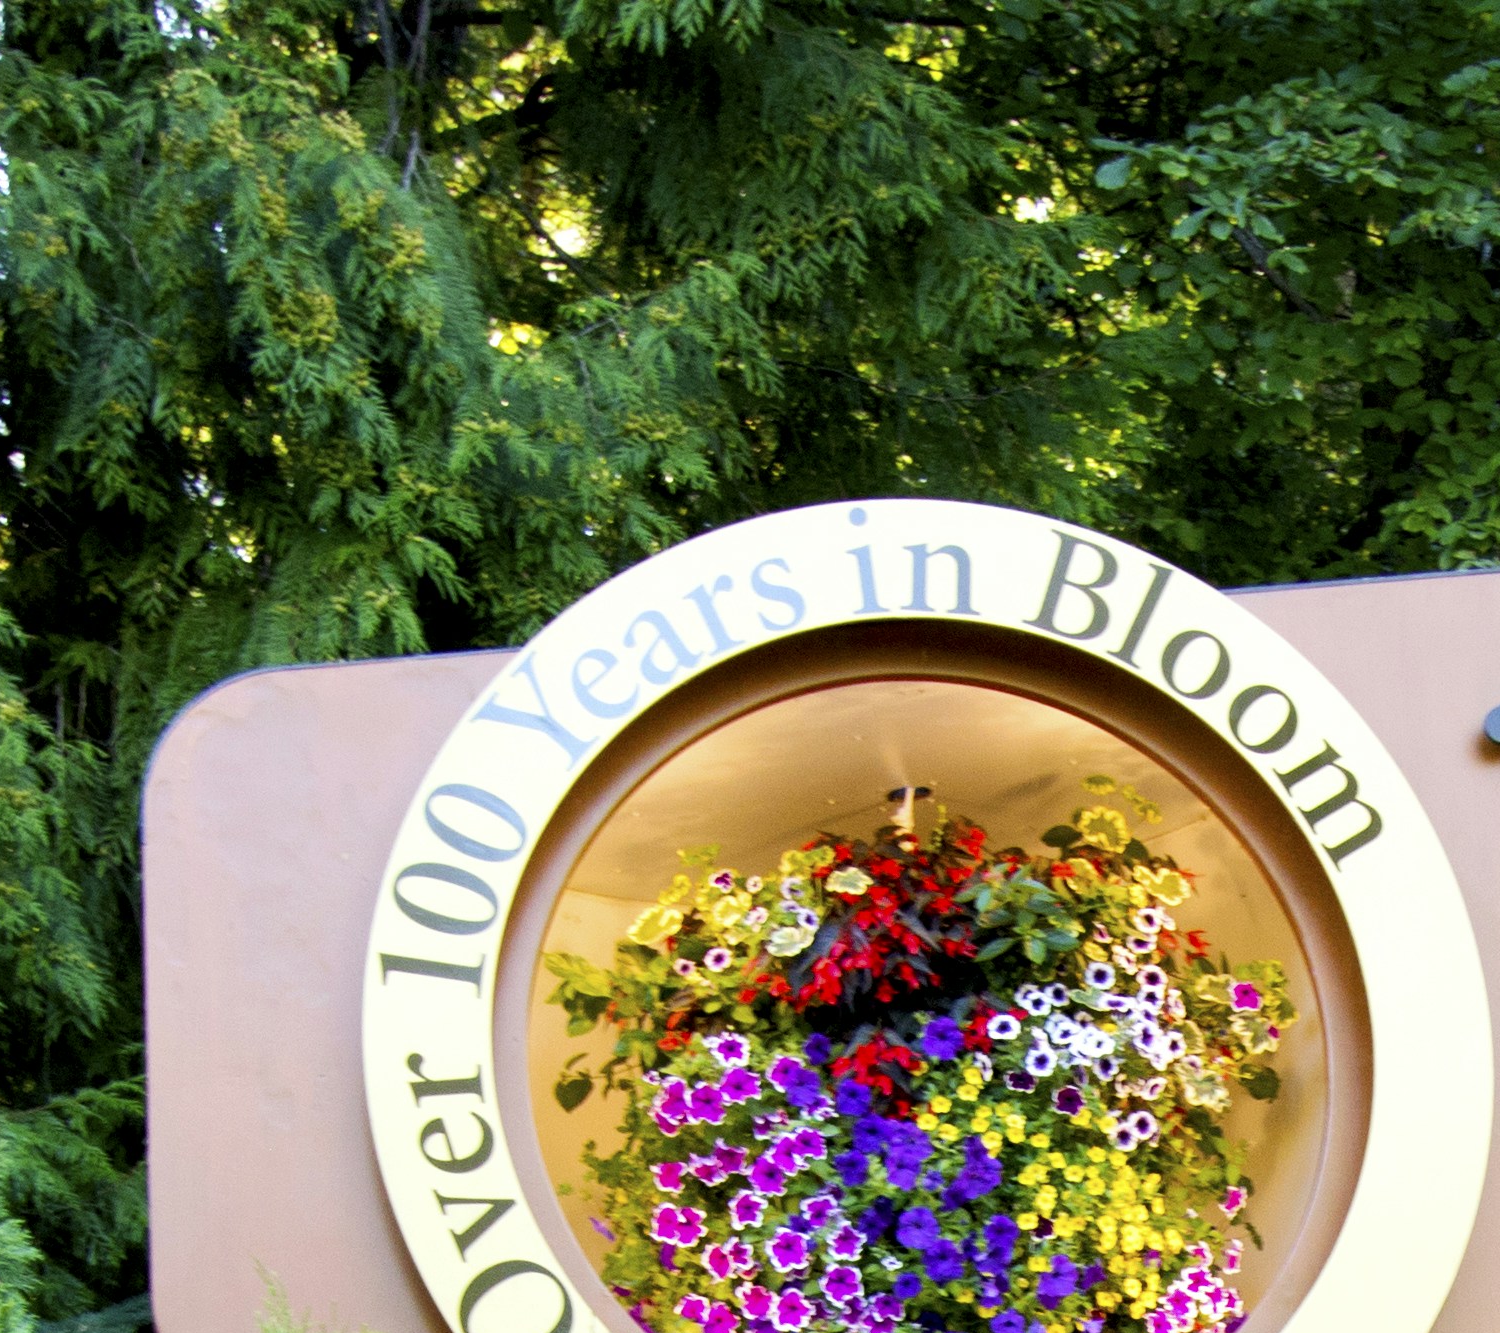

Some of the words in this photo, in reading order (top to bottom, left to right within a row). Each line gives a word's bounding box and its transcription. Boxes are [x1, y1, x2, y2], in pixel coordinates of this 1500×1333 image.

[381, 780, 528, 1001] 100
[474, 554, 808, 772] Years
[848, 505, 982, 616] in
[1025, 528, 1386, 873] Bloom
